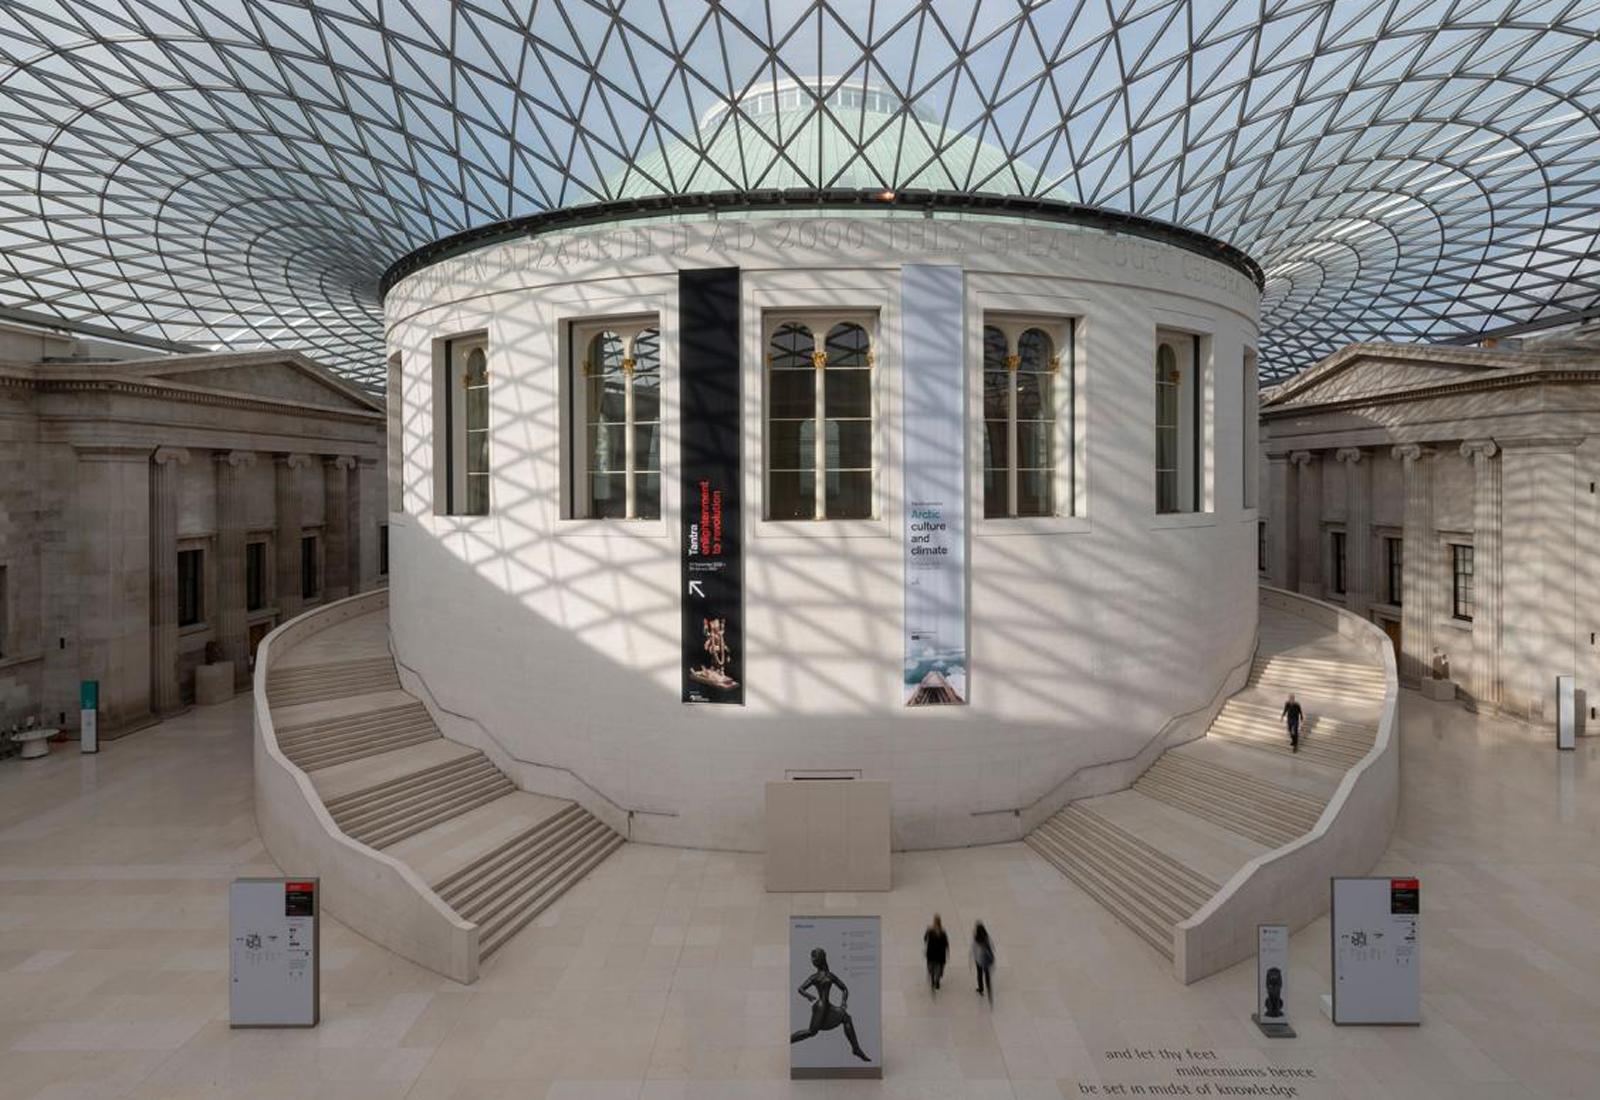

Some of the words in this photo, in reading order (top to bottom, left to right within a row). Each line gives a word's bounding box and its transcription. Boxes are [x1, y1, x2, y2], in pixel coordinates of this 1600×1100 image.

[706, 222, 757, 252] AD
[775, 220, 865, 249] 2000
[884, 221, 964, 253] THIS
[978, 226, 1081, 260] GREAT
[712, 491, 721, 541] revolution
[911, 509, 940, 519] Arctic
[911, 522, 946, 531] culture
[688, 524, 698, 556] Tantra
[911, 534, 930, 543] and
[712, 543, 721, 554] to
[911, 545, 948, 555] climate
[1106, 1049, 1132, 1060] and
[1134, 1049, 1153, 1060] let
[1159, 1049, 1182, 1062] thy
[1187, 1049, 1217, 1060] feet
[1176, 1065, 1266, 1077] millenniums
[1268, 1065, 1316, 1077] hence
[1079, 1082, 1099, 1094] be
[1102, 1083, 1125, 1094] set
[1130, 1083, 1145, 1094] in
[1148, 1082, 1191, 1095] midst
[1194, 1082, 1210, 1095] of
[1215, 1082, 1299, 1097] knowledge
